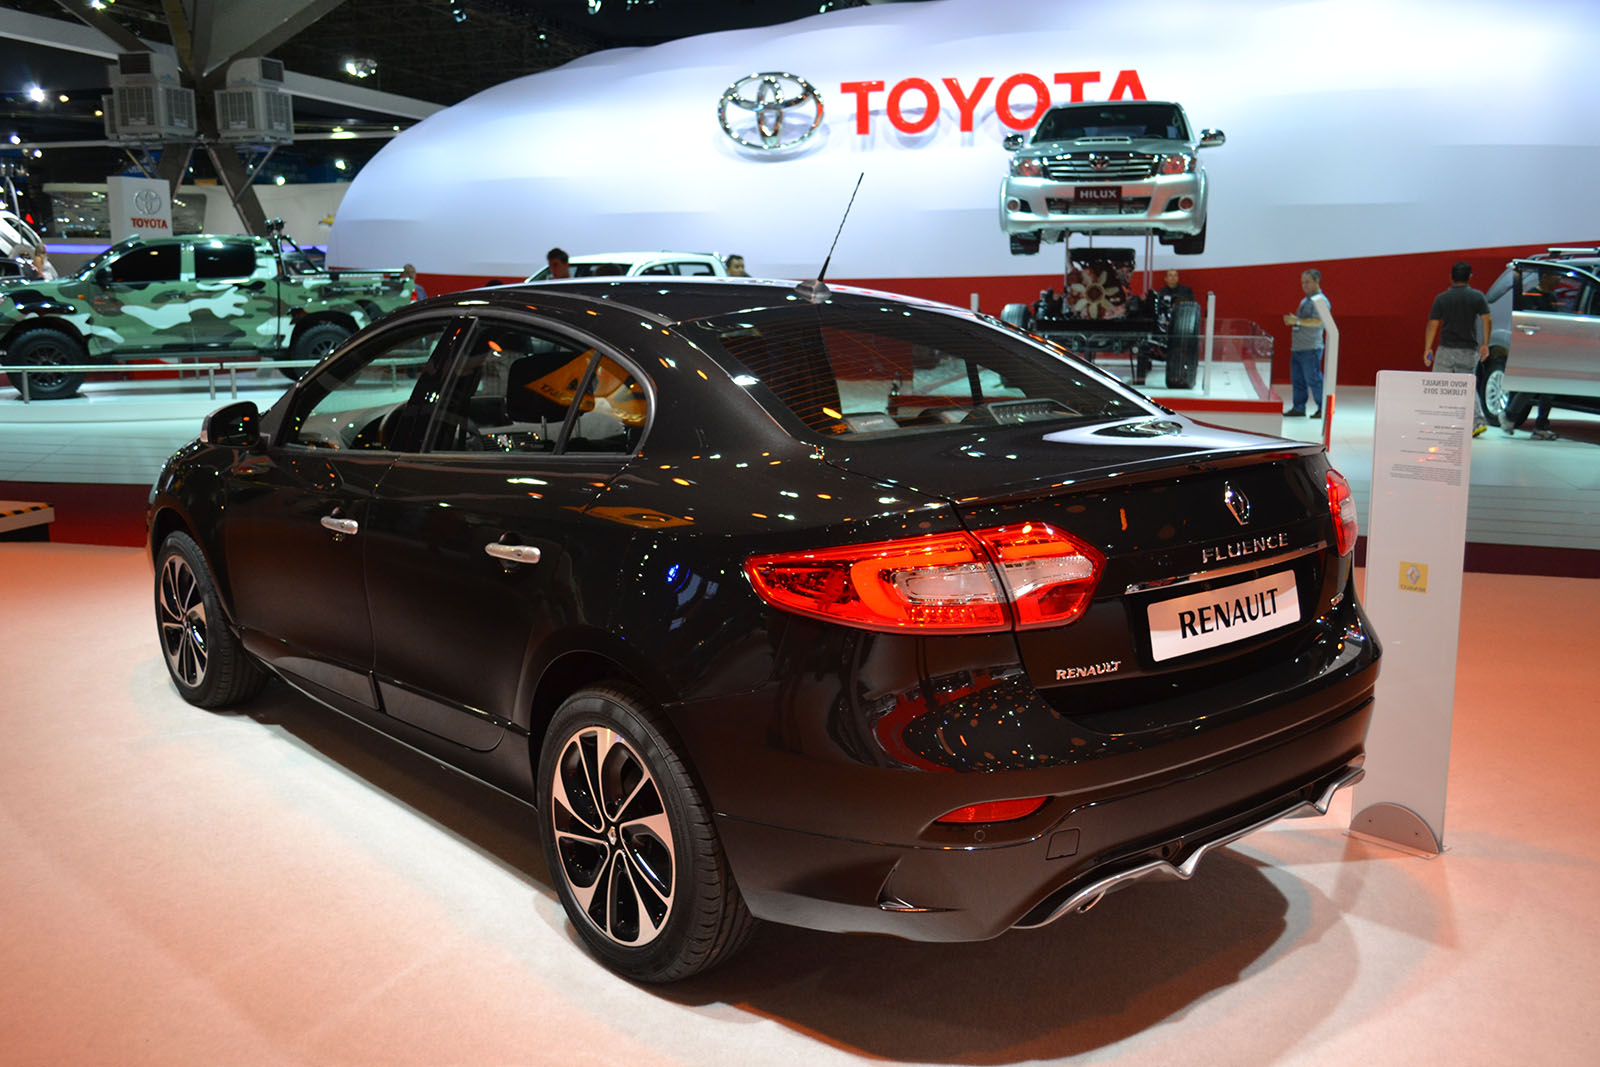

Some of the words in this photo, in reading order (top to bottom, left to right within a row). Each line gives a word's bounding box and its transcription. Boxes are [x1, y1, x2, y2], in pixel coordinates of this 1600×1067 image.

[840, 69, 1148, 135] TOYOTA
[1080, 190, 1117, 199] HILUX
[131, 217, 168, 229] TOYOTA
[1202, 532, 1289, 563] FLUENCE
[1178, 588, 1278, 639] RENAULT
[1056, 660, 1121, 680] RENAULT
